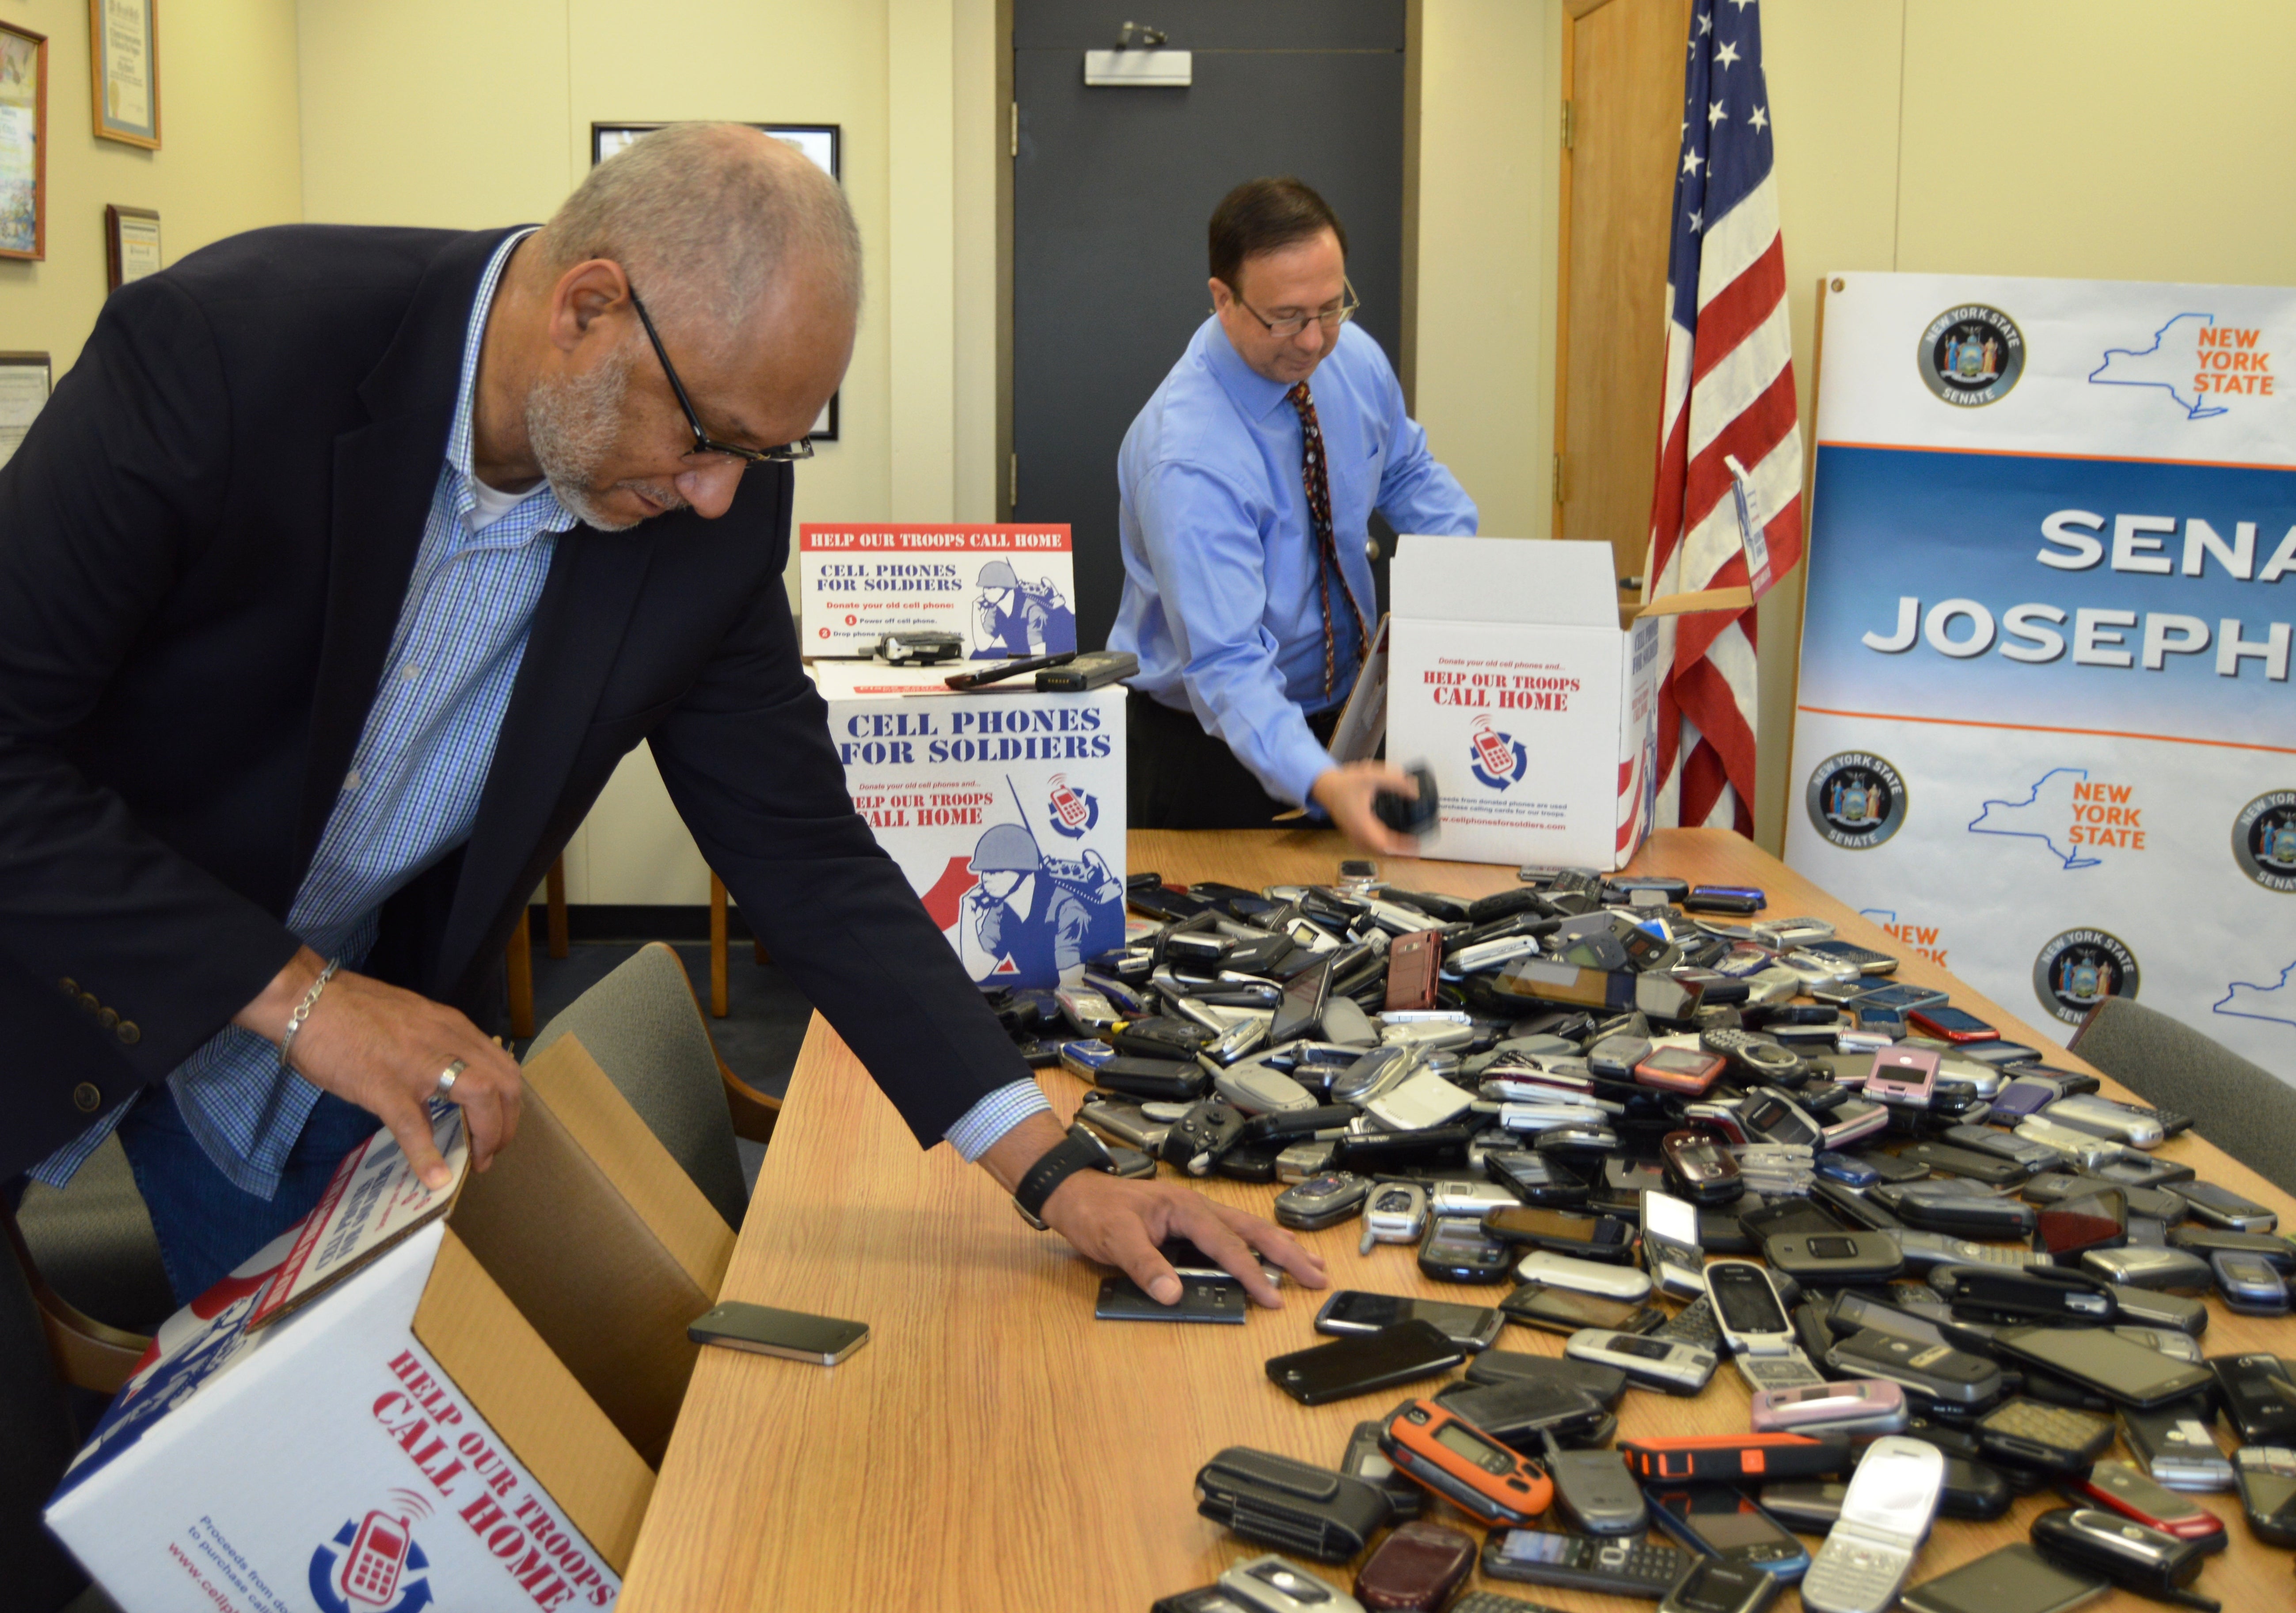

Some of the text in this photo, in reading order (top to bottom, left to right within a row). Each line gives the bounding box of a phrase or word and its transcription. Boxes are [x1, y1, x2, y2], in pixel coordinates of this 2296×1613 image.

[1925, 307, 2021, 348] NEW YORK STATE
[2199, 327, 2260, 349] NEW
[2197, 350, 2270, 372] YORK
[2193, 373, 2274, 395] STATE
[1942, 387, 1995, 405] SENATE
[810, 533, 1061, 548] HELP OUR TROOPS CALL HOME
[821, 564, 956, 577] CELL PHONES
[817, 579, 962, 591] FOR SOLDIERS
[1861, 596, 2291, 680] JOSEPH
[1438, 657, 1465, 665] Donate
[1514, 661, 1543, 670] phones
[1424, 671, 1580, 692] HELP OUR TROOPS
[1433, 686, 1568, 712] CALL HOME
[847, 708, 1101, 738] CELL PHONES
[840, 734, 1112, 765] FOR SOLDIERS
[933, 780, 959, 789] phones
[1813, 754, 1903, 795] NEW YORK STATE
[890, 795, 925, 807] OUR
[930, 793, 993, 806] TROOPS
[2074, 782, 2133, 804] NEW
[918, 807, 982, 826] HOME
[2072, 803, 2141, 828] YORK
[2240, 798, 2266, 826] NEW
[1828, 829, 1877, 847] SENATE
[2068, 825, 2146, 850] STATE
[1883, 923, 1939, 945] NEW
[2041, 931, 2135, 973] NEW YORK STATE
[2056, 1007, 2088, 1024] SEN
[387, 1348, 617, 1607] HELP OUR TROOPS
[372, 1390, 576, 1613] CALL HOME
[188, 1525, 201, 1540] to
[198, 1541, 248, 1594] purchase
[200, 1515, 290, 1613] Proceeds from do
[169, 1541, 239, 1613] www.cellp
